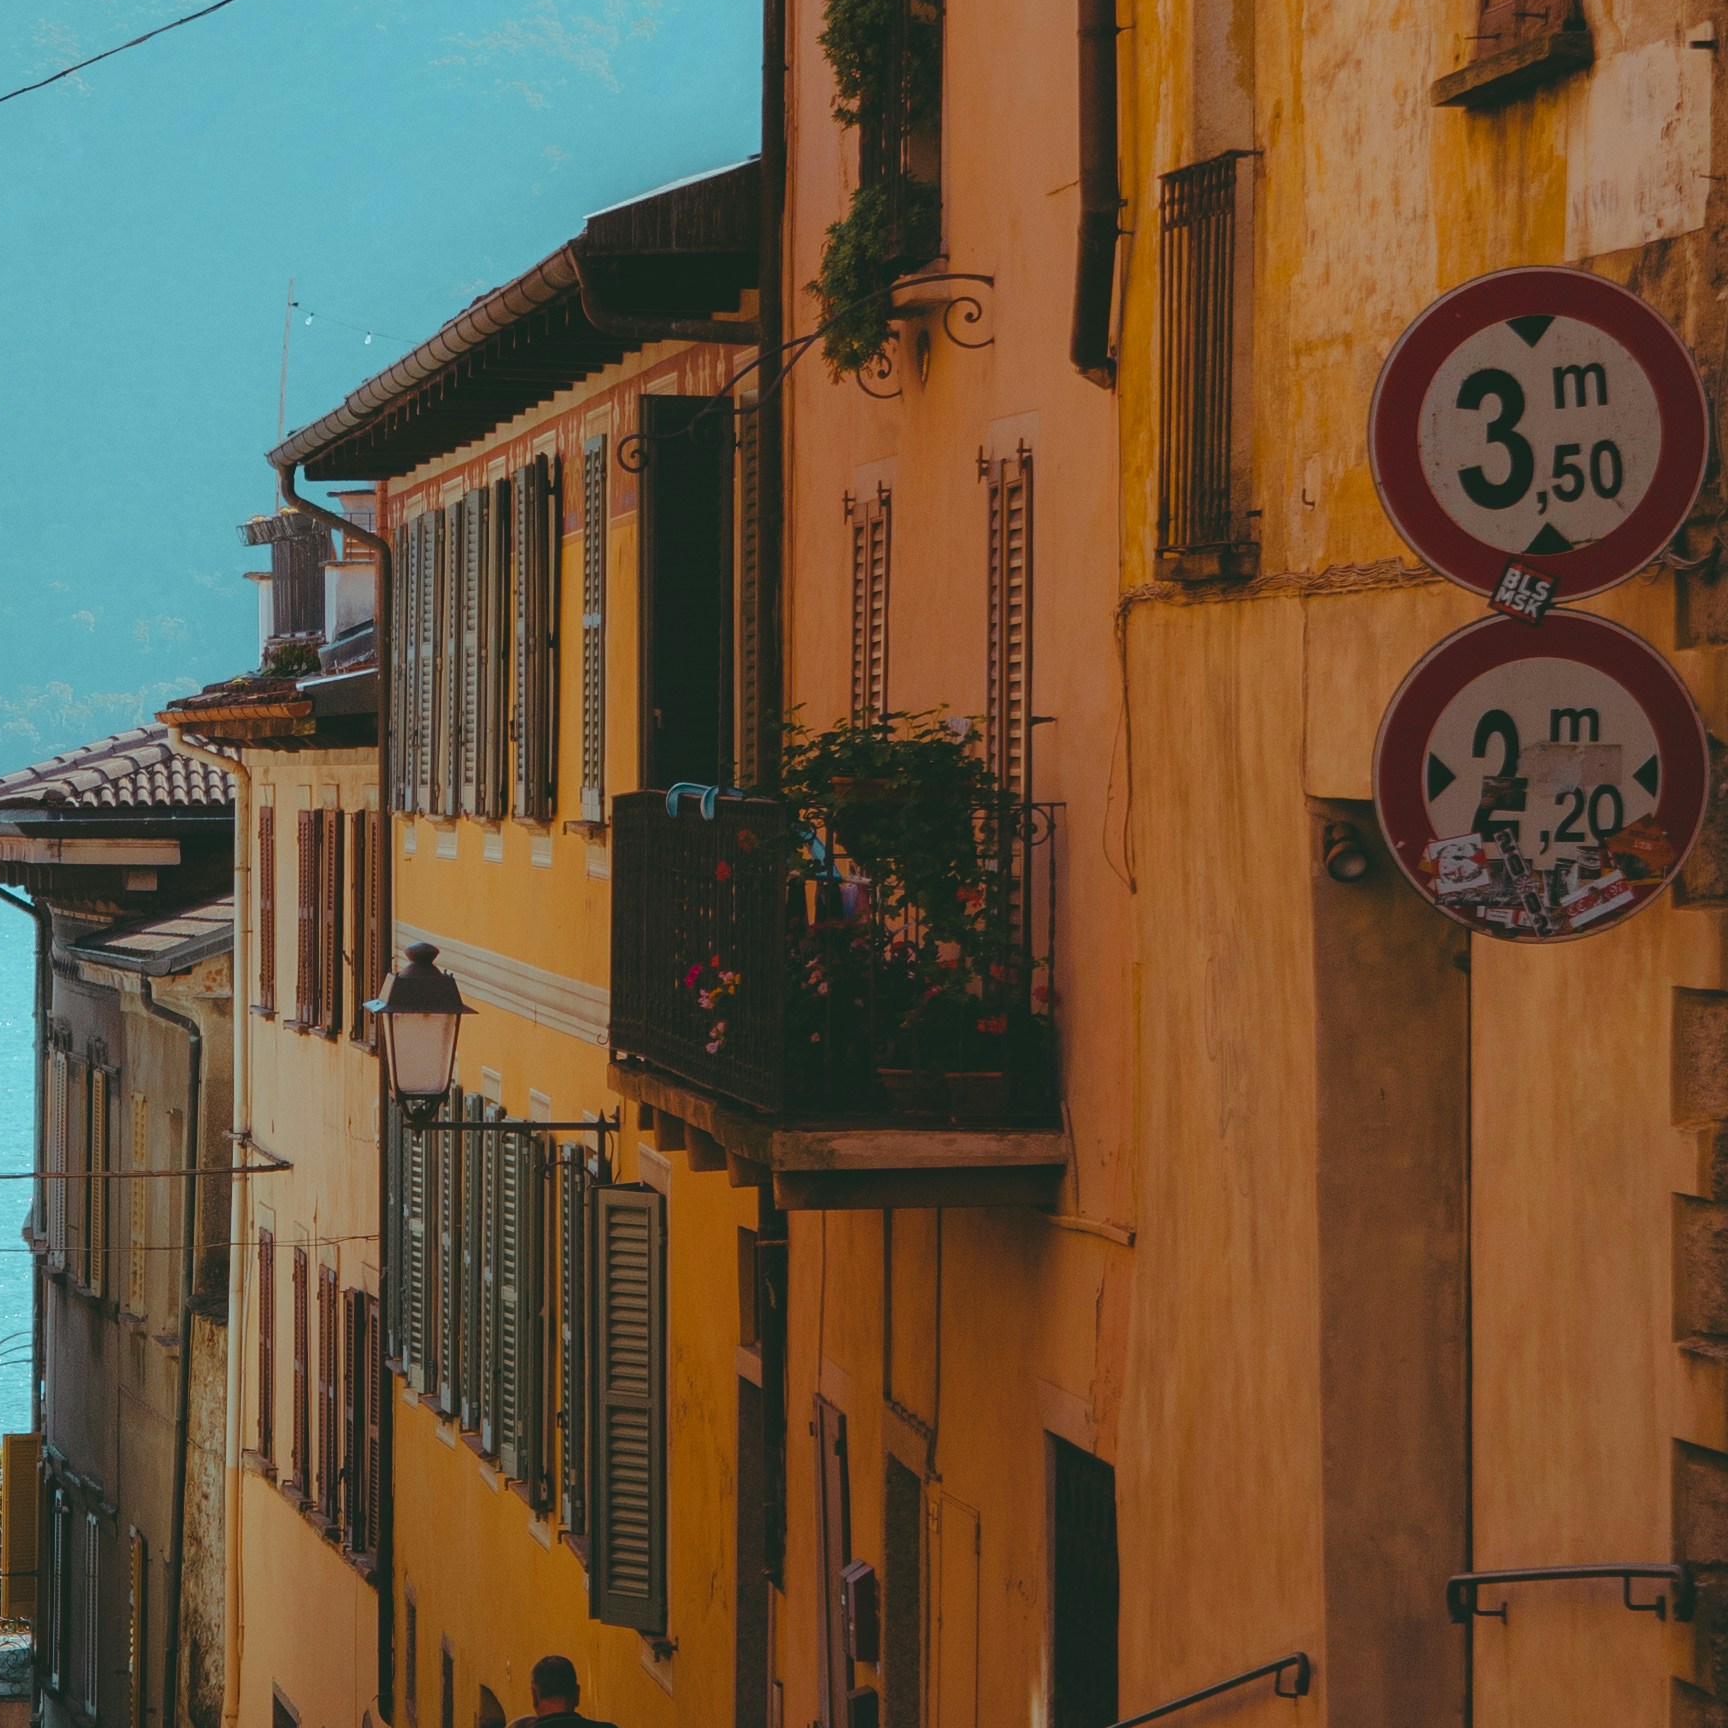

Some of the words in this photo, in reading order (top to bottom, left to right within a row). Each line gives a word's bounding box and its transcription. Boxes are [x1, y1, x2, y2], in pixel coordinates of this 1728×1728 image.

[1552, 362, 1608, 409] m
[1494, 585, 1543, 619] MSK
[1502, 567, 1551, 602] BLS
[1550, 707, 1600, 742] m
